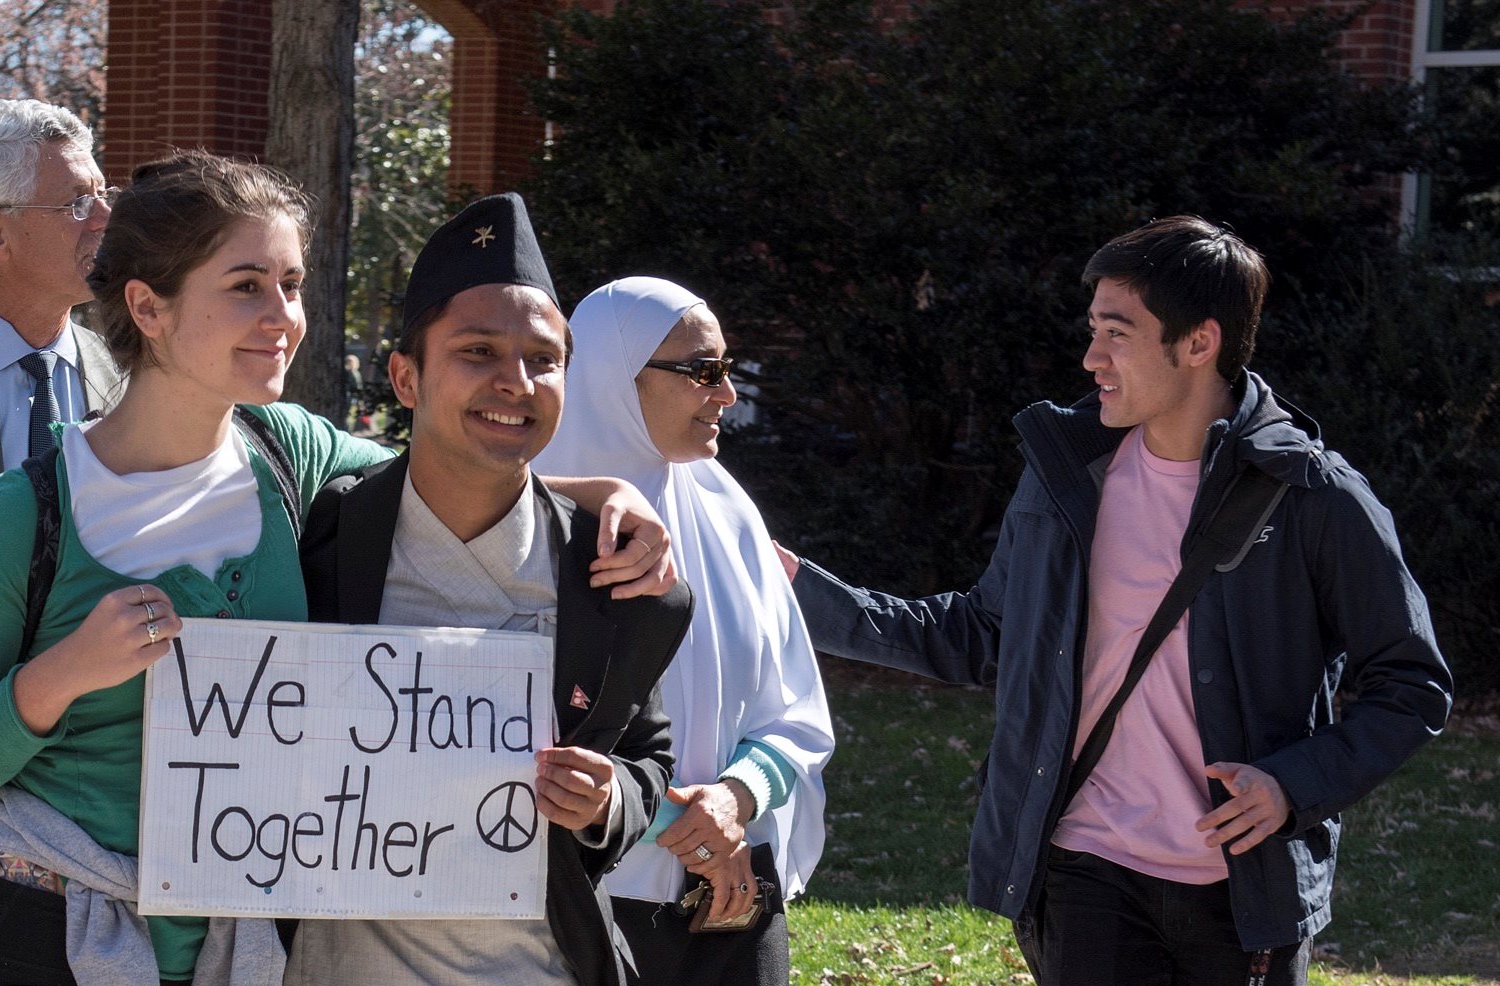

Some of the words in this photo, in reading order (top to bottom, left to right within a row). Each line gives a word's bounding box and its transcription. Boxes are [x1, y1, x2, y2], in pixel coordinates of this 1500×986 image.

[172, 636, 305, 745] We
[348, 641, 534, 754] Stand
[168, 761, 455, 888] Together
